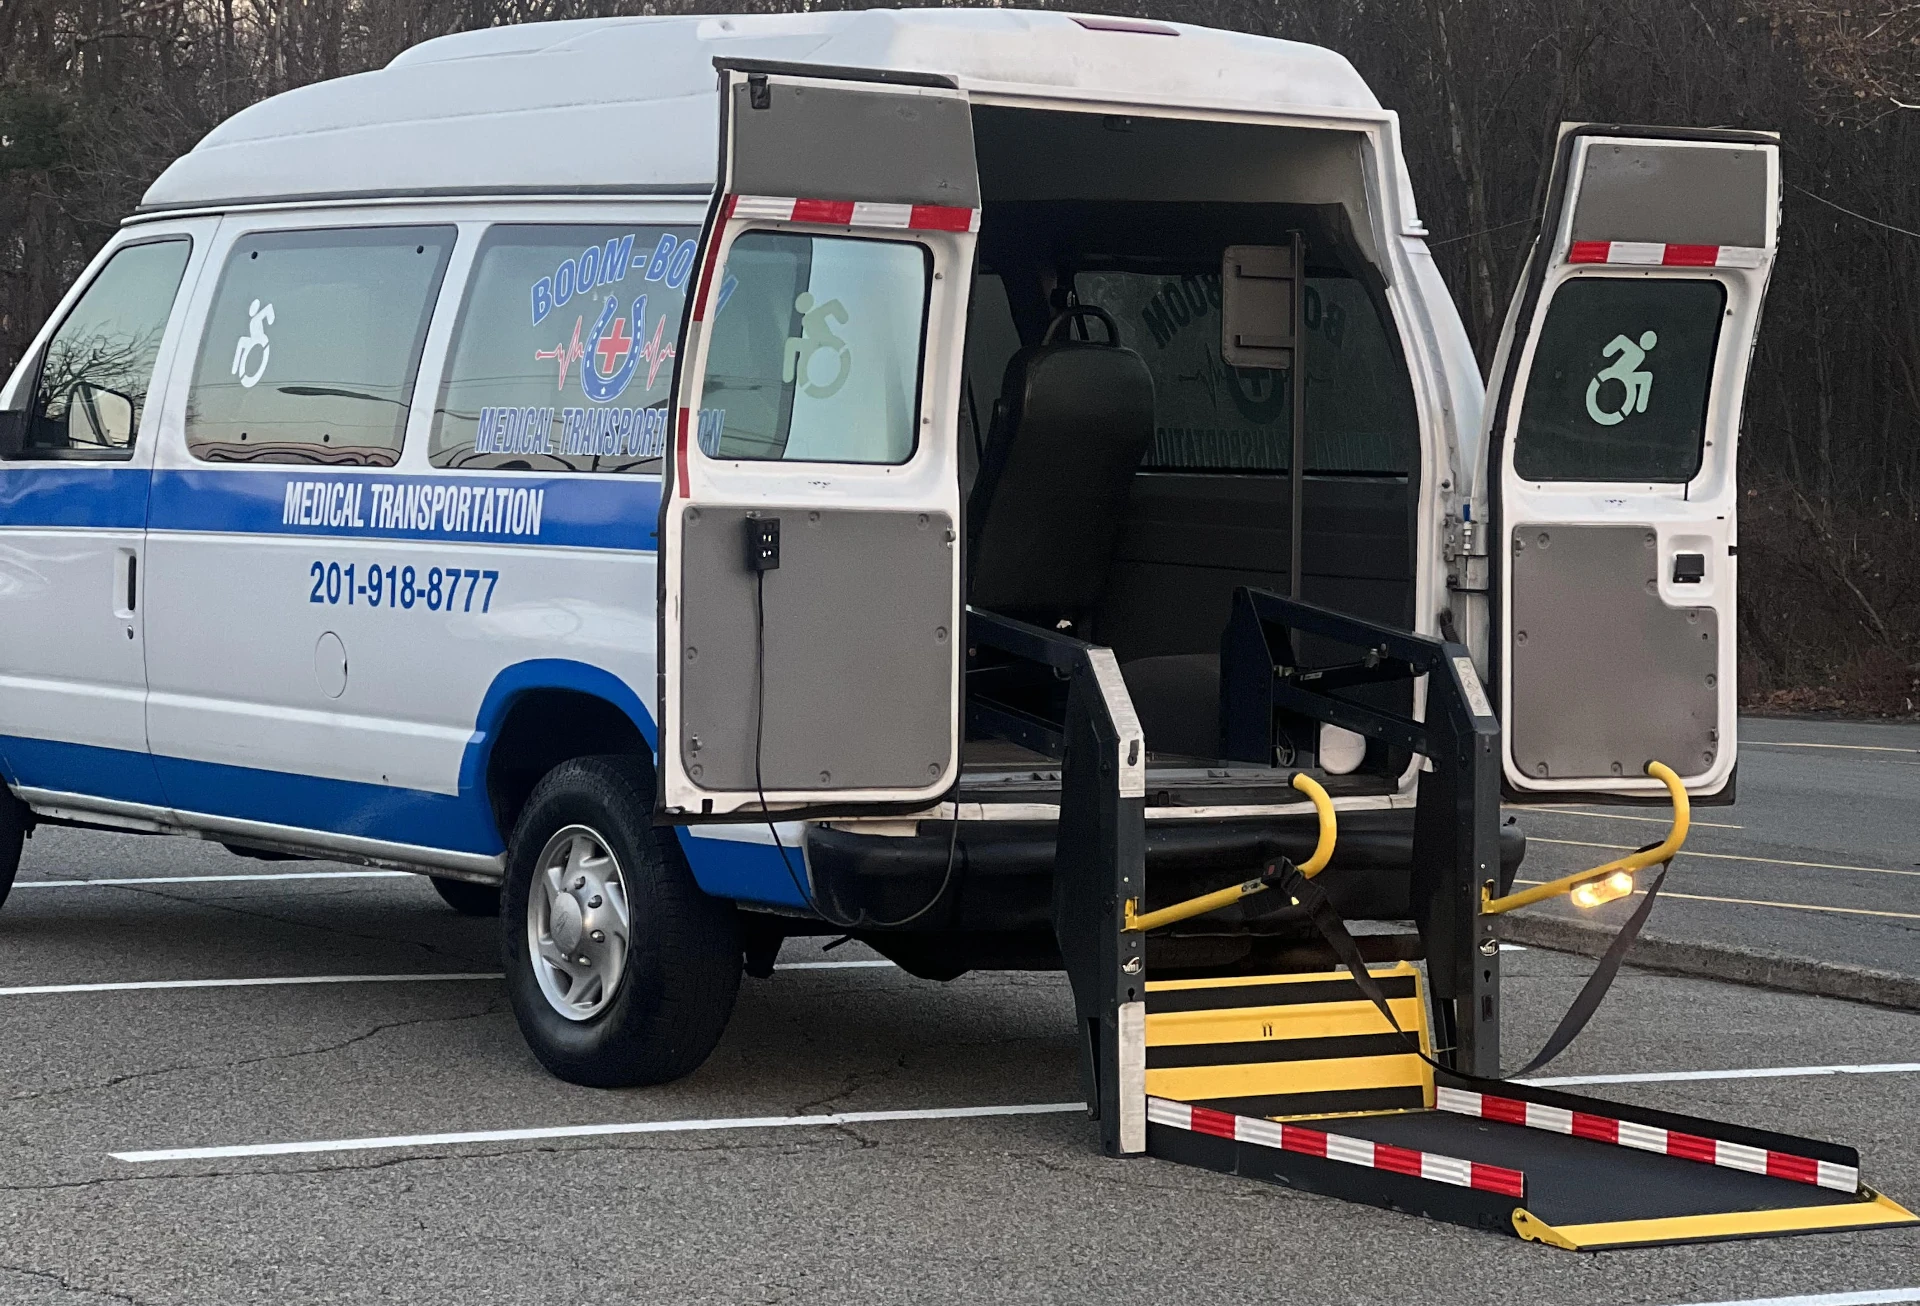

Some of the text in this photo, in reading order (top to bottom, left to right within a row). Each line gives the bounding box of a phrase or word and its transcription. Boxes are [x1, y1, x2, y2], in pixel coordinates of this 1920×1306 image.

[531, 233, 739, 326] BOOM-BO
[475, 406, 726, 457] MEDICAL TRANSPORTON
[283, 481, 544, 535] MEDICAL TRANSPORTATION
[309, 561, 499, 613] 201-918-8777
